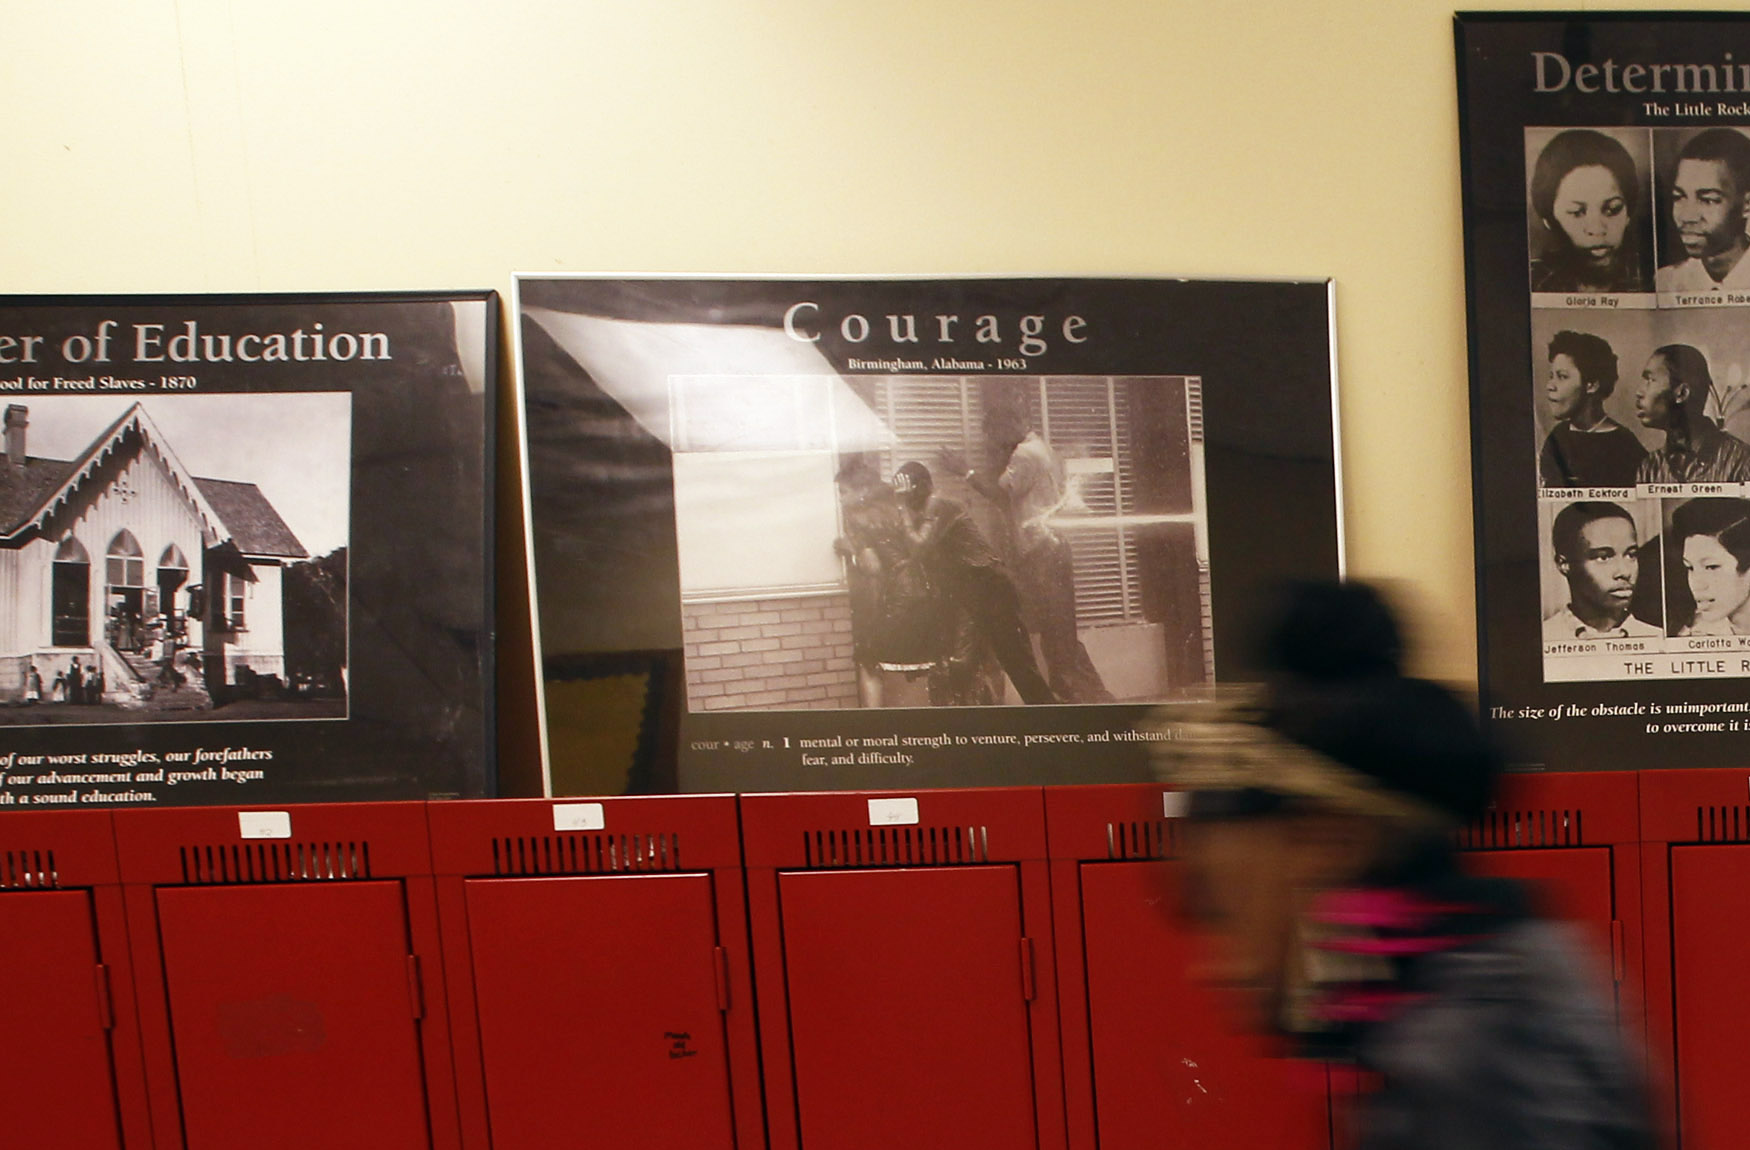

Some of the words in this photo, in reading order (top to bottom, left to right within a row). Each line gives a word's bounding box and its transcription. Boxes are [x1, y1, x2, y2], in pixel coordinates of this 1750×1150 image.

[1643, 102, 1669, 116] The
[1675, 102, 1711, 116] Little
[1566, 297, 1596, 306] Gloria
[1601, 297, 1619, 308] Ray
[783, 302, 1088, 357] Courage
[62, 320, 119, 363] of
[132, 320, 393, 363] Education
[848, 358, 928, 373] Birmingham,
[931, 358, 985, 370] Alabama
[996, 358, 1027, 370] 1963
[27, 376, 50, 390] for
[53, 376, 95, 390] Freed
[99, 376, 146, 390] Slaves
[160, 376, 197, 390] 1870
[1648, 485, 1683, 494] Ernest
[1691, 484, 1722, 493] Green
[1544, 643, 1596, 654] Jefferson
[1606, 641, 1645, 651] Thomas
[1688, 639, 1732, 649] Carlotta
[1624, 663, 1654, 675] THE
[1671, 661, 1726, 674] LITTLE
[1490, 706, 1514, 719] The
[1518, 705, 1545, 721] size
[1549, 704, 1564, 721] of
[1567, 704, 1587, 717] the
[1591, 702, 1646, 717] obstacle
[1650, 702, 1662, 715] is
[1645, 722, 1660, 733] to
[1663, 722, 1725, 733] overcome
[1729, 720, 1739, 731] it
[799, 736, 842, 749] mental
[845, 739, 860, 748] or
[863, 734, 898, 748] moral
[901, 733, 952, 749] strength
[955, 735, 967, 745] to
[971, 735, 1021, 746] venture,
[1024, 733, 1085, 747] persevere,
[1087, 730, 1110, 743] and
[1113, 728, 1171, 742] withstand
[0, 752, 17, 770] of
[17, 755, 45, 766] our
[47, 753, 87, 766] worst
[90, 749, 161, 768] struggles,
[165, 752, 192, 763] our
[193, 748, 273, 765] forefathers
[802, 753, 828, 766] fear,
[831, 752, 854, 765] and
[858, 752, 914, 767] difficulty.
[6, 775, 35, 785] our
[36, 771, 132, 785] advancement
[135, 769, 164, 783] and
[166, 767, 217, 786] growth
[221, 767, 264, 784] began
[18, 795, 30, 805] a
[32, 790, 78, 804] sound
[81, 789, 157, 803] education.
